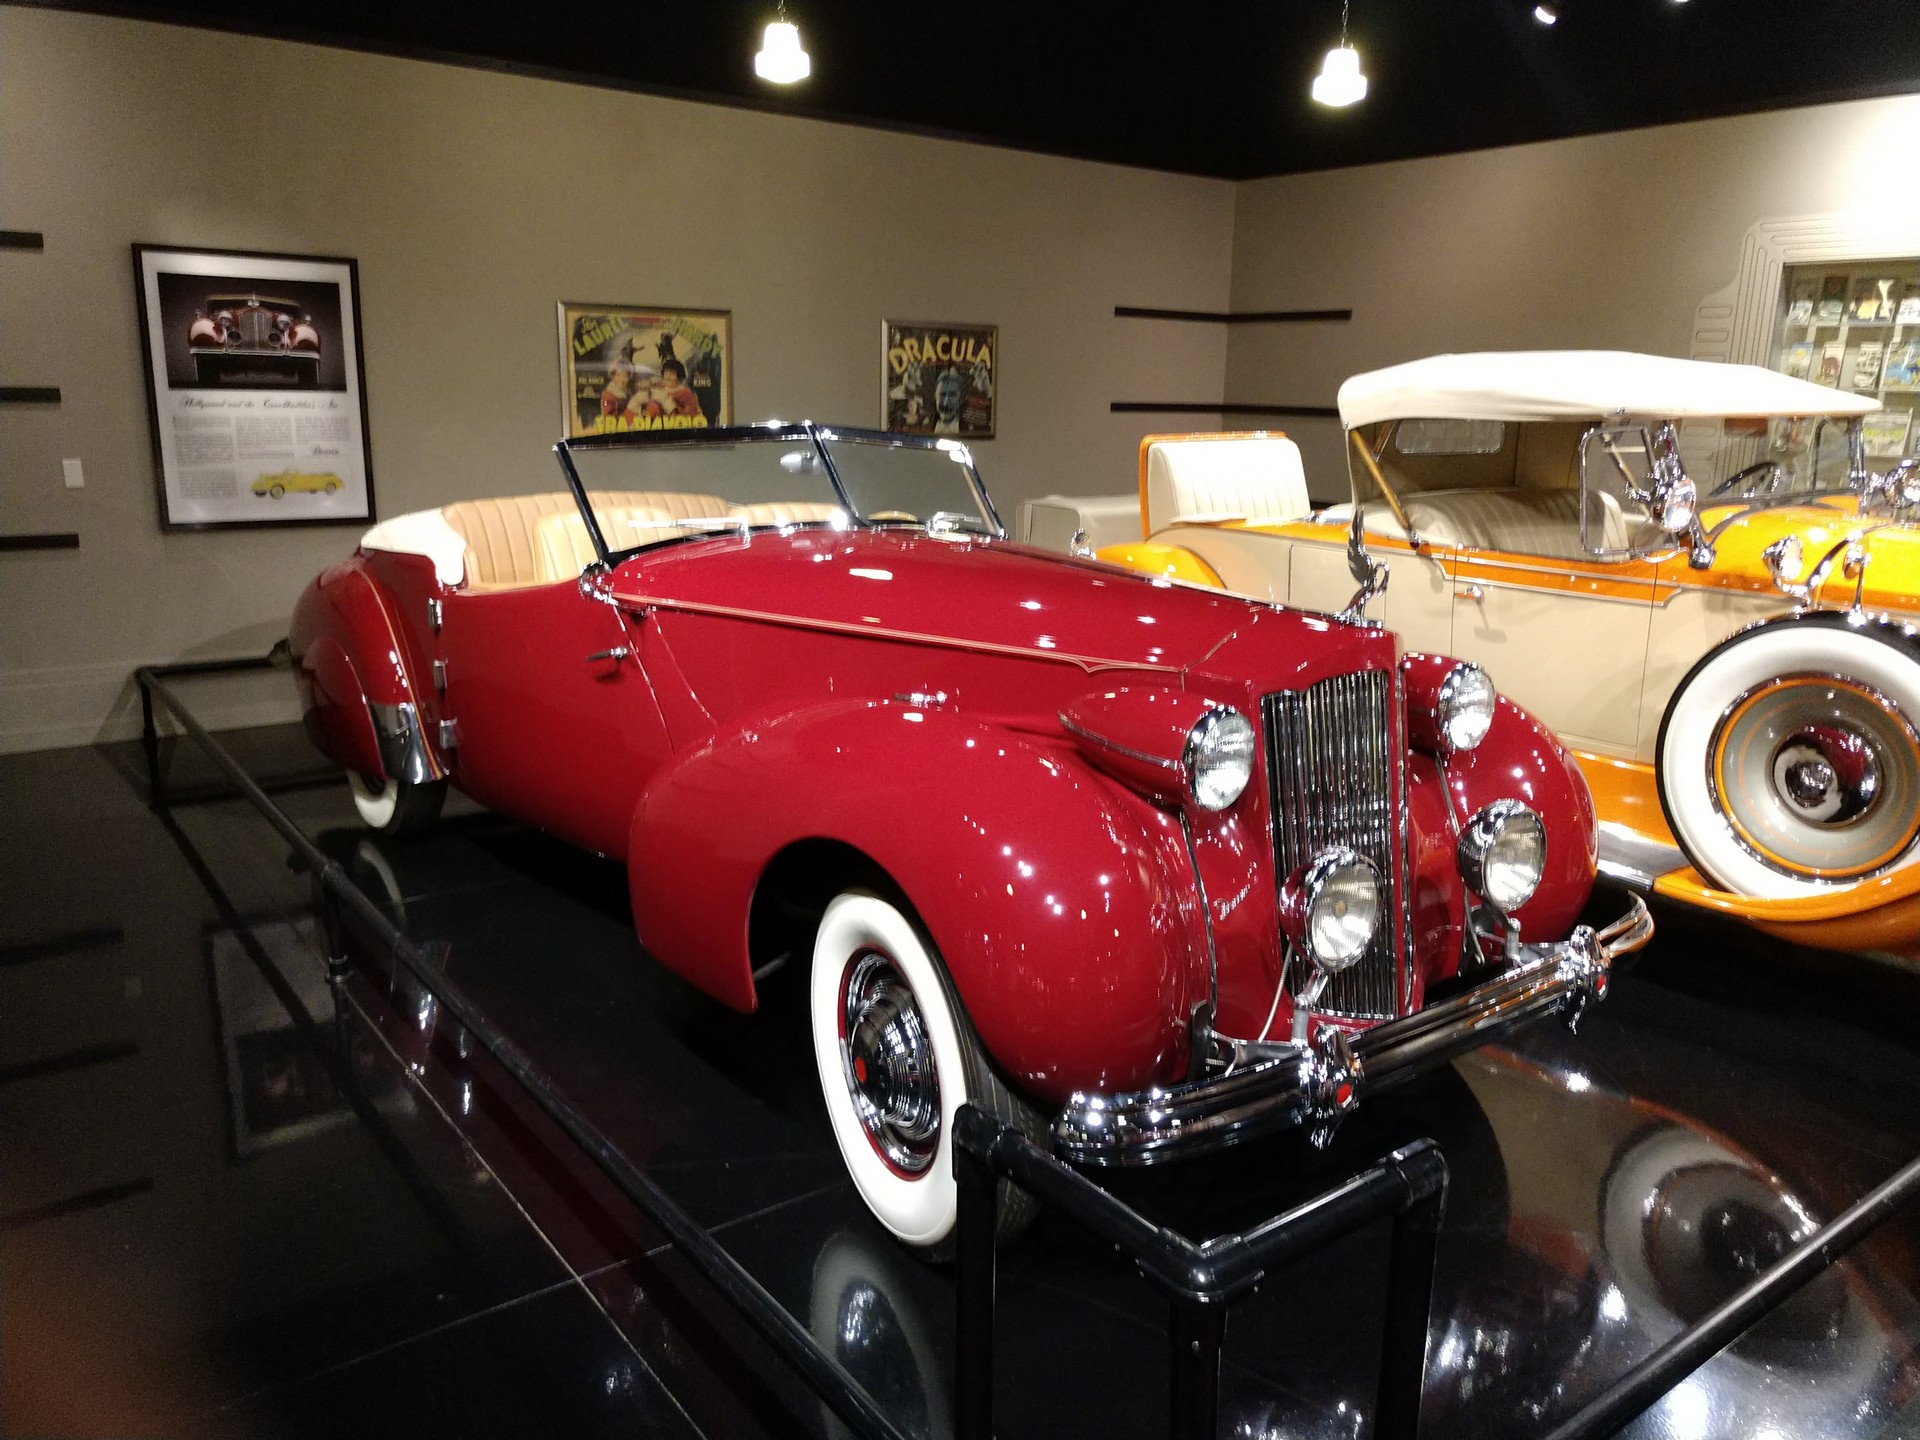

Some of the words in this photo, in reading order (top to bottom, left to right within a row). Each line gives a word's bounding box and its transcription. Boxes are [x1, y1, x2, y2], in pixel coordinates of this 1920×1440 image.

[575, 316, 628, 355] LAUREL
[673, 318, 723, 357] HARDY
[889, 335, 991, 374] DRACULA
